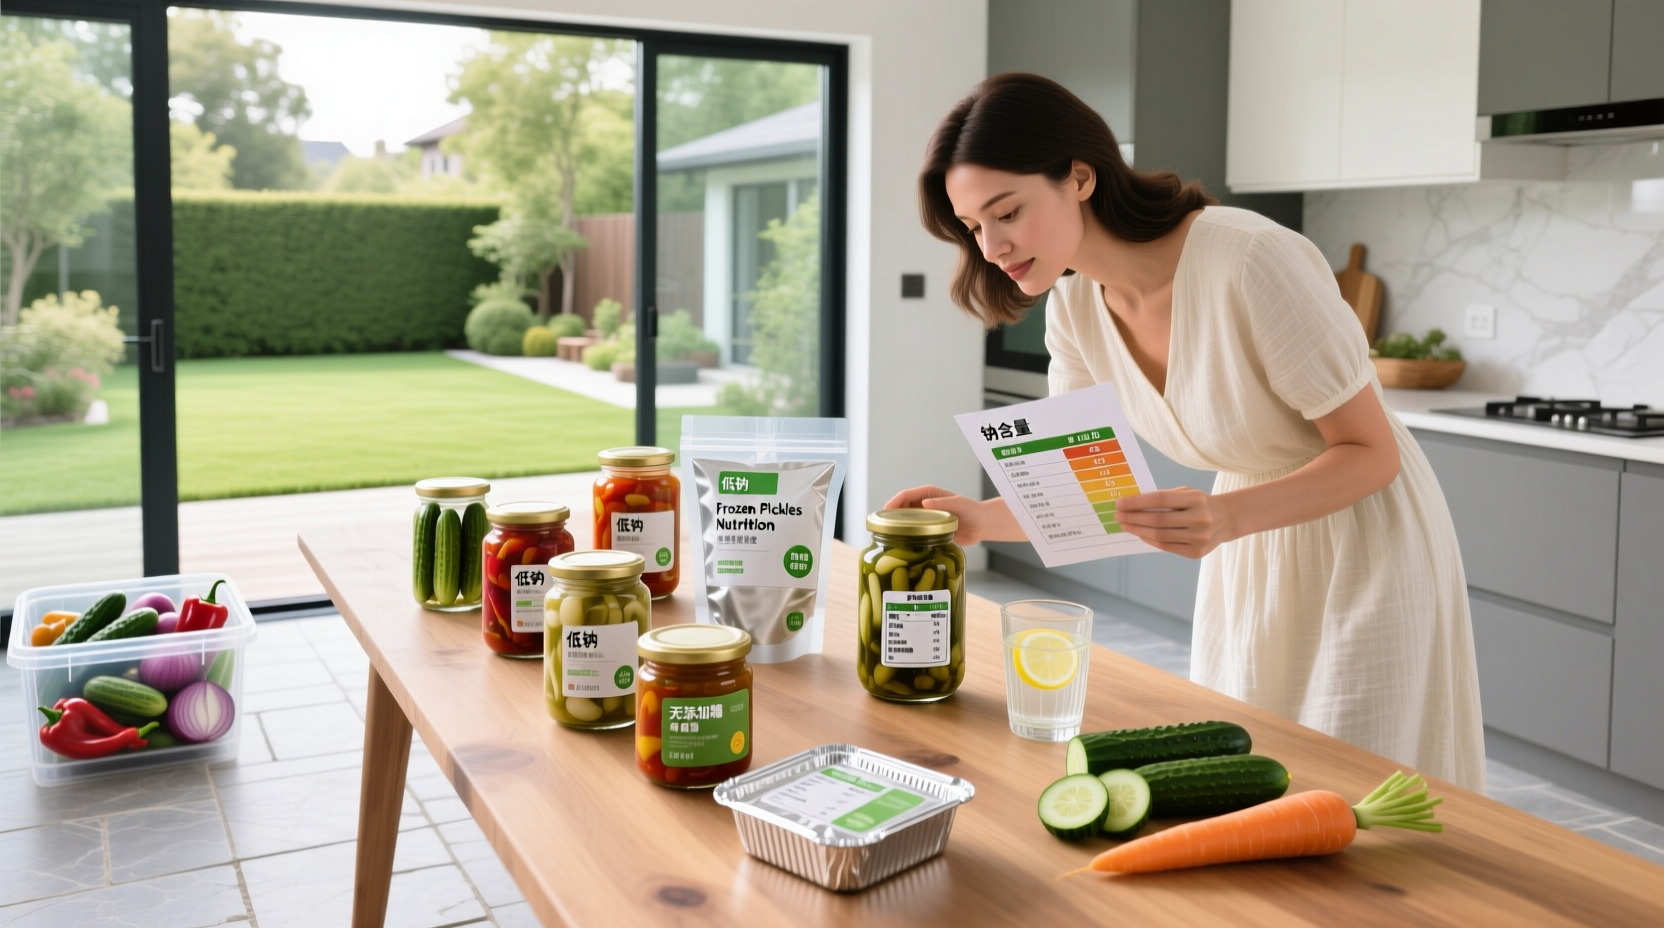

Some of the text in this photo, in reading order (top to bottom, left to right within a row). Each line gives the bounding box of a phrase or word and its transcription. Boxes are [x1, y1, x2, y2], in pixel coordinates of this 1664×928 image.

[981, 418, 1032, 441] 钠含量
[716, 502, 756, 515] Frozen
